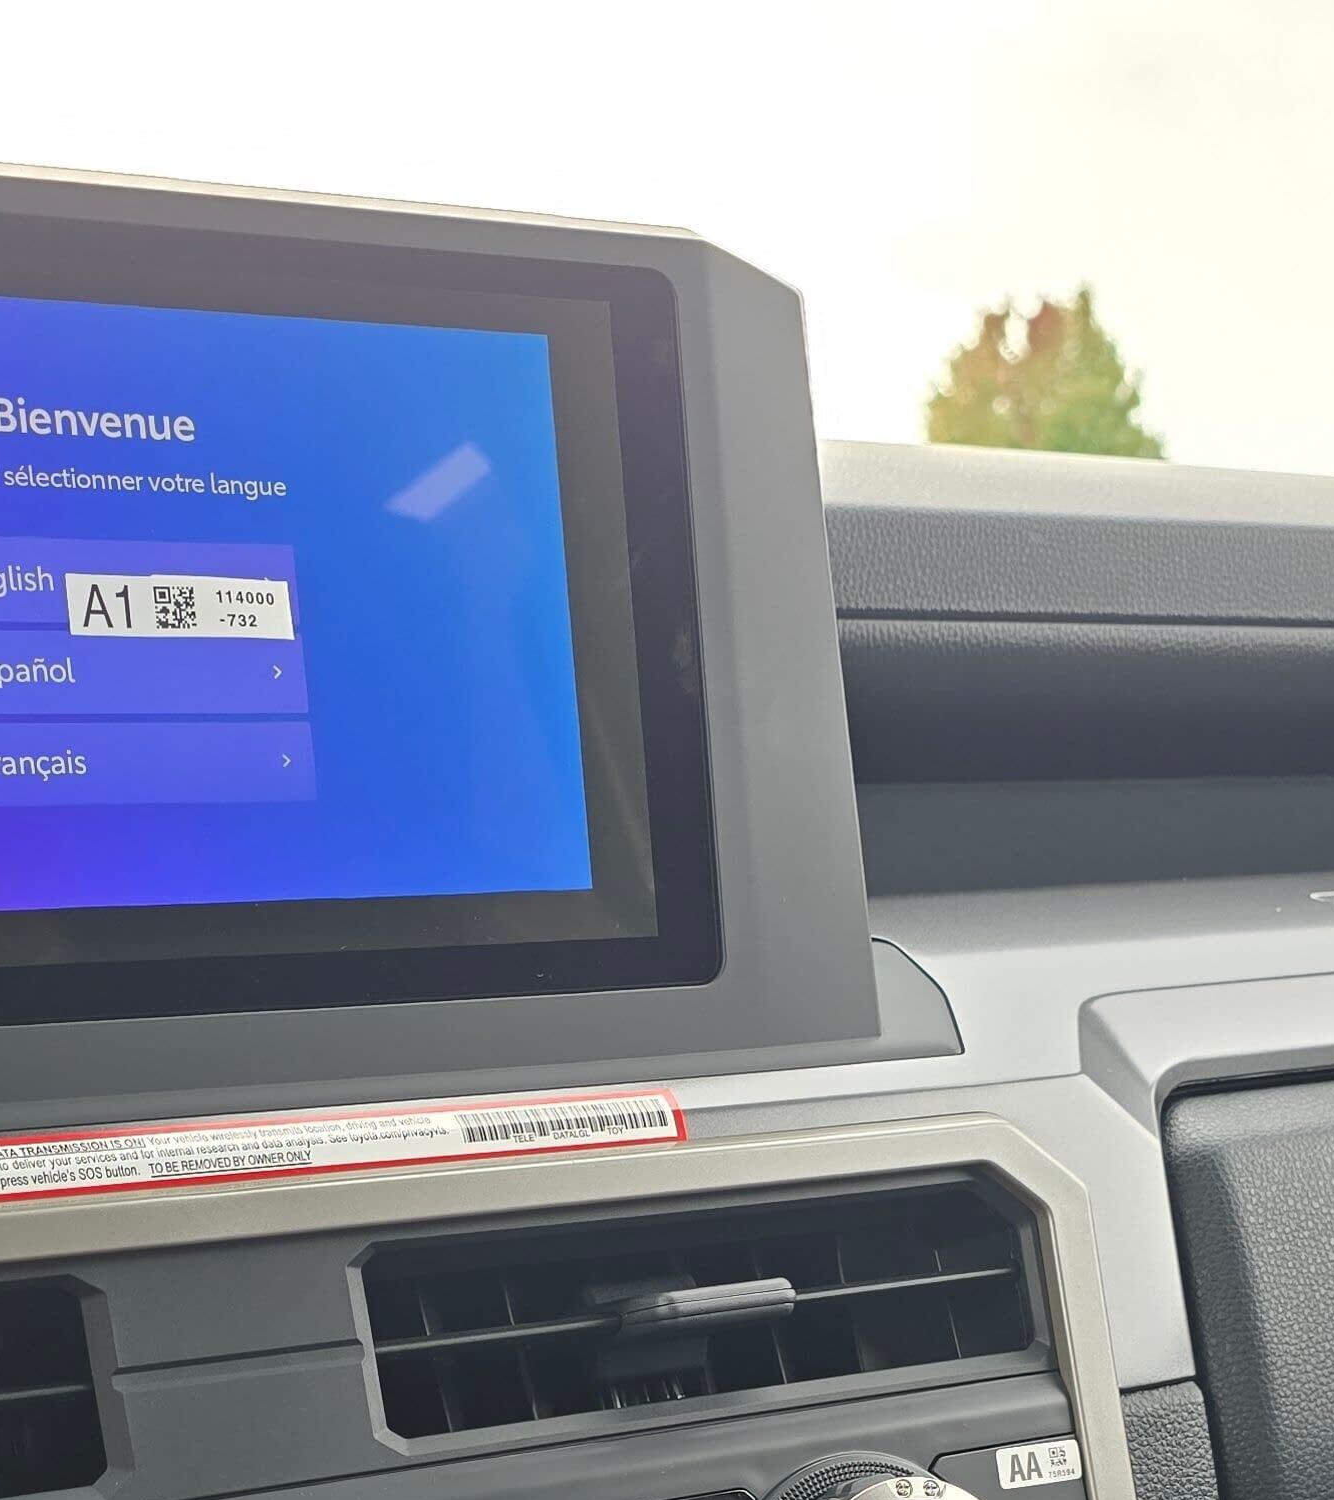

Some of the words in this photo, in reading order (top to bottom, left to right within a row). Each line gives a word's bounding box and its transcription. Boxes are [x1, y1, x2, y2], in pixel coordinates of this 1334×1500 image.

[4, 465, 143, 492] sélectionner
[148, 470, 205, 494] votre
[211, 472, 286, 501] langue
[83, 583, 133, 629] A1
[215, 590, 275, 606] 114000
[219, 613, 258, 628] -732
[12, 1157, 46, 1170] deliver
[49, 1157, 71, 1170] your
[74, 1151, 117, 1165] services
[119, 1149, 138, 1161] and
[139, 1148, 154, 1159] for
[157, 1145, 195, 1158] internal
[196, 1141, 239, 1154] research
[241, 1139, 259, 1150] and
[261, 1138, 282, 1149] data
[328, 1133, 347, 1143] See
[20, 1140, 108, 1156] TRANSMISSION
[110, 1139, 122, 1148] IS
[147, 1135, 170, 1145] Your
[172, 1132, 208, 1144] vehicle
[211, 1128, 257, 1143] wirelessly
[345, 1119, 377, 1132] driving
[513, 1133, 535, 1144] TELE
[0, 1175, 28, 1189] press
[31, 1169, 76, 1184] vehicle's
[78, 1167, 103, 1180] SOS
[105, 1164, 140, 1178] button.
[148, 1162, 163, 1173] TO
[165, 1161, 179, 1172] BE
[181, 1156, 230, 1171] REMOVED
[232, 1155, 246, 1167] BY
[247, 1152, 285, 1165] OWNER
[286, 1150, 311, 1162] ONLY
[1009, 1451, 1044, 1484] AA
